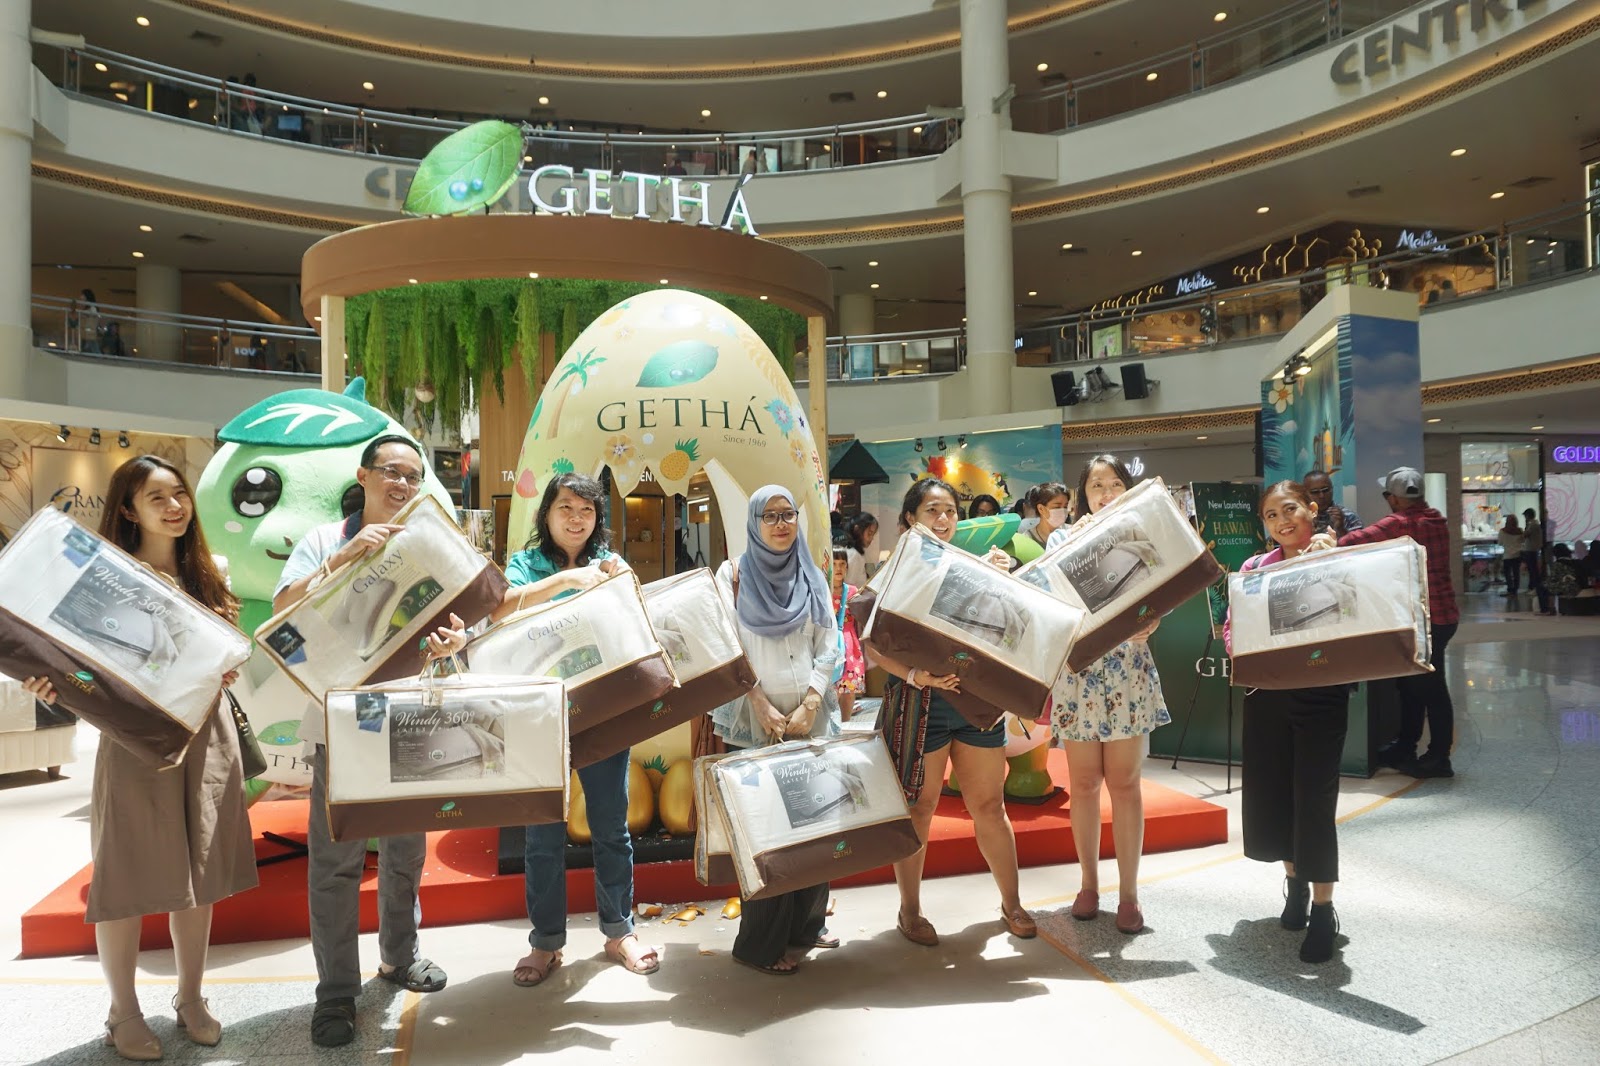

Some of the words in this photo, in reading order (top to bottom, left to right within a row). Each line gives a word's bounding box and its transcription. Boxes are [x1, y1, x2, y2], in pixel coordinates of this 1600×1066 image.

[1330, 0, 1538, 84] CENTR
[528, 165, 759, 236] GETHÁ
[597, 396, 765, 435] GETHÁ
[723, 434, 746, 445] Since
[748, 437, 767, 448] 1969
[1554, 446, 1600, 463] GOLD
[1493, 461, 1509, 476] 25
[1208, 500, 1222, 509] New
[1224, 500, 1251, 512] Launching
[1217, 538, 1253, 546] COLLECTION
[352, 549, 404, 594] Galaxy
[1066, 546, 1099, 573] Windy
[94, 565, 141, 605] Windy
[138, 595, 172, 616] 360°
[1271, 573, 1306, 594] Windy
[527, 611, 580, 641] Galaxy
[395, 710, 441, 736] Windy
[444, 711, 475, 724] 360°
[776, 763, 811, 783] Windy
